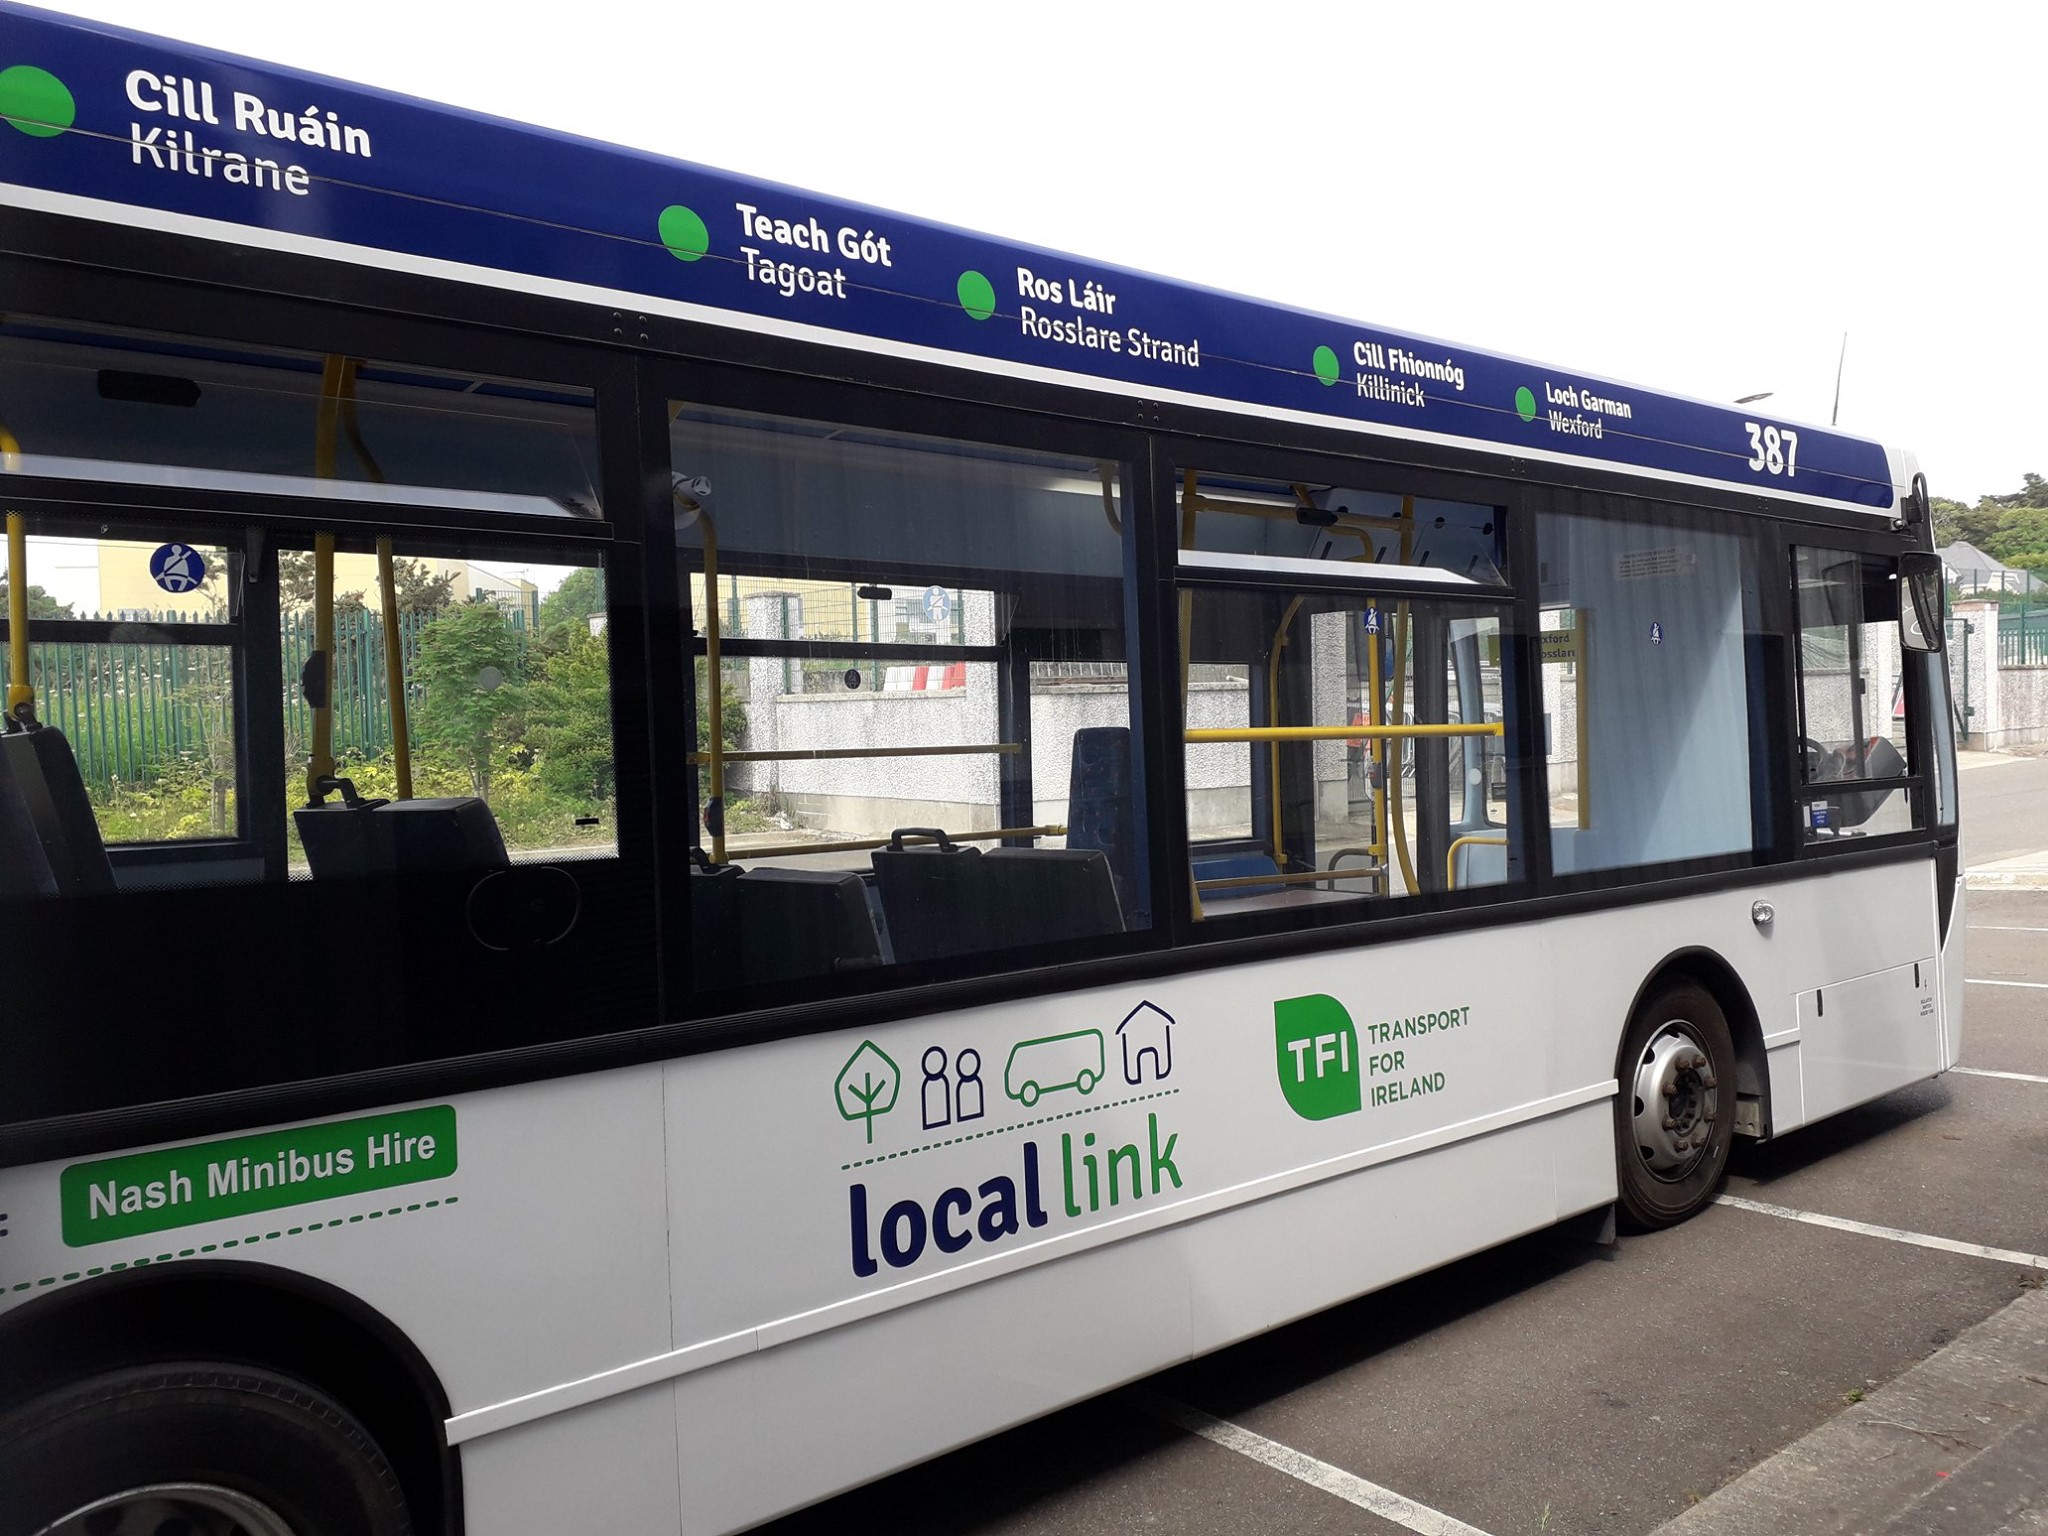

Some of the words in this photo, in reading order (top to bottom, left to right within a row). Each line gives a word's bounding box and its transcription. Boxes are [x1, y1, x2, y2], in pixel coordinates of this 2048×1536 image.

[126, 70, 218, 124] Cill
[234, 92, 371, 157] Ruáin
[130, 123, 309, 195] Kilrane
[736, 203, 829, 253] Teach
[838, 228, 891, 266] Gót
[740, 247, 846, 298] Tagoat
[1017, 267, 1063, 303] Ros
[1069, 279, 1115, 314] Láir
[1021, 306, 1121, 352] Rosslare
[1128, 328, 1199, 367] Strand
[1354, 342, 1385, 369] Cill
[1388, 349, 1464, 390] Fhionnóg
[1357, 373, 1424, 407] Killinick
[1546, 382, 1579, 407] Loch
[1581, 390, 1631, 418] Garman
[1548, 409, 1602, 438] Wexford
[1745, 422, 1797, 478] 387
[1542, 633, 1570, 643] xford
[1368, 1007, 1469, 1044] TRANSPORT
[1288, 1031, 1349, 1082] TFI
[1370, 1051, 1404, 1076] FOR
[1372, 1073, 1444, 1106] IRELAND
[90, 1170, 191, 1219] Nash
[208, 1149, 354, 1197] Minibus
[368, 1133, 435, 1168] Hire
